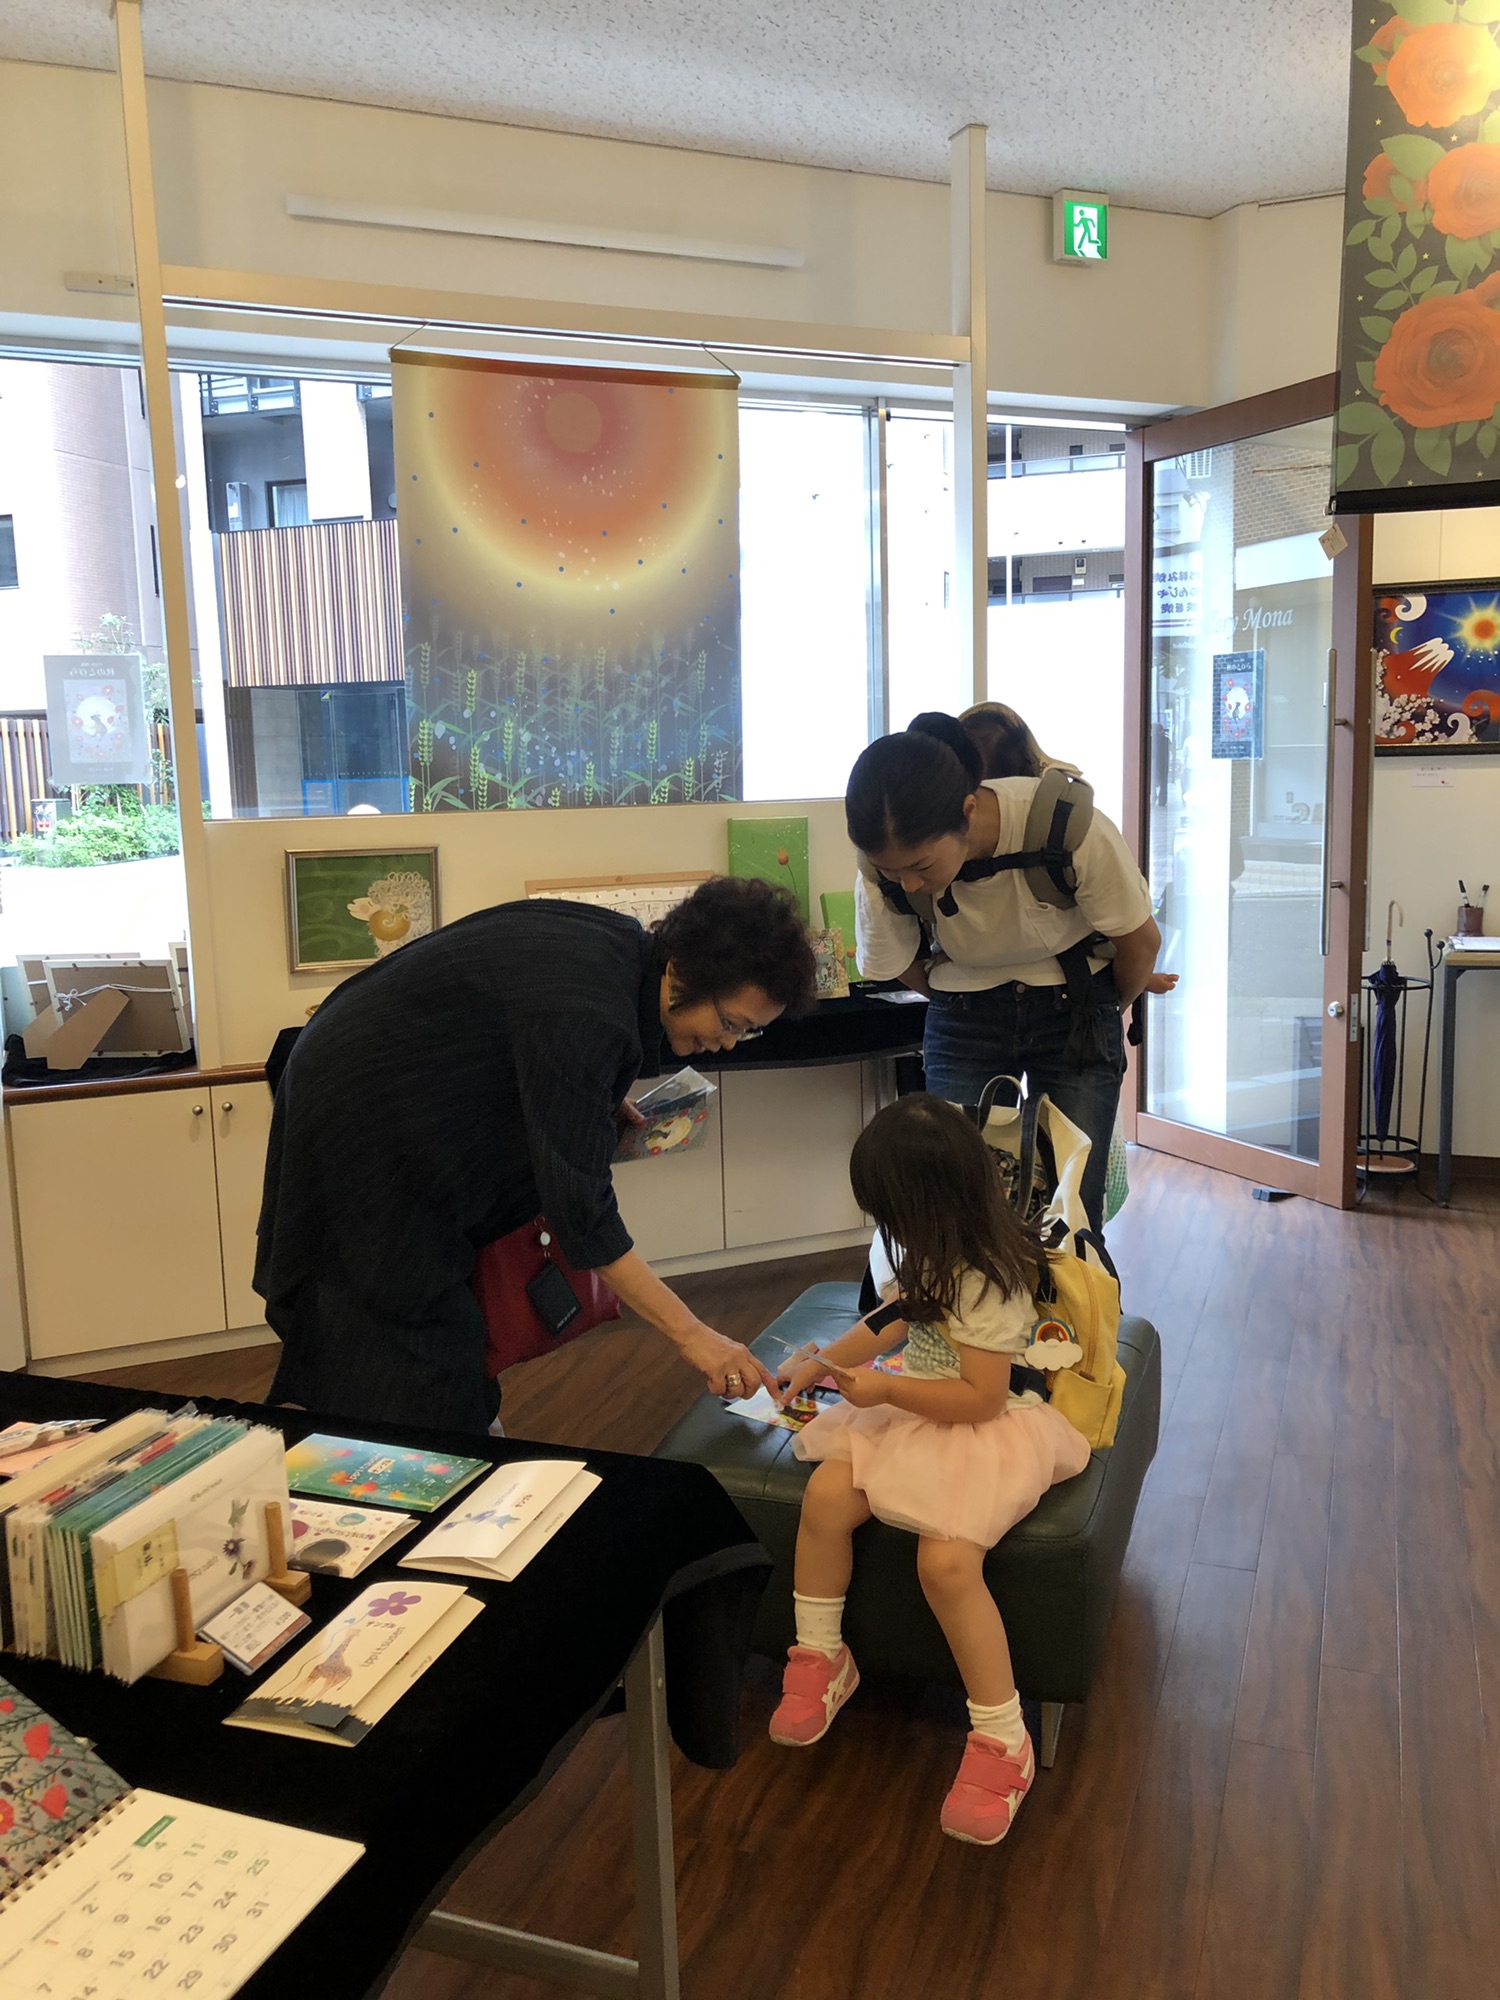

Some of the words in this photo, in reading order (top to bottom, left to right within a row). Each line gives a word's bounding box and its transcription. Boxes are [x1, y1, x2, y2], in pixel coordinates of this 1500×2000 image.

[1242, 606, 1294, 632] Mona
[37, 1982, 52, 1993] 7
[76, 1947, 94, 1959] 8
[113, 1914, 130, 1924] 9
[149, 1872, 174, 1889] 10
[183, 1842, 206, 1857] 11
[82, 1903, 99, 1914] 2
[117, 1871, 134, 1882] 3
[154, 1840, 168, 1850] 4
[109, 1950, 136, 1967] 15
[146, 1915, 172, 1932] 16
[181, 1881, 204, 1898] 17
[214, 1849, 239, 1866] 18
[143, 1959, 170, 1980] 22
[178, 1924, 204, 1944] 23
[213, 1890, 238, 1910] 24
[246, 1858, 270, 1877] 25
[177, 1969, 203, 1990] 29
[212, 1933, 238, 1954] 30
[246, 1901, 270, 1919] 31
